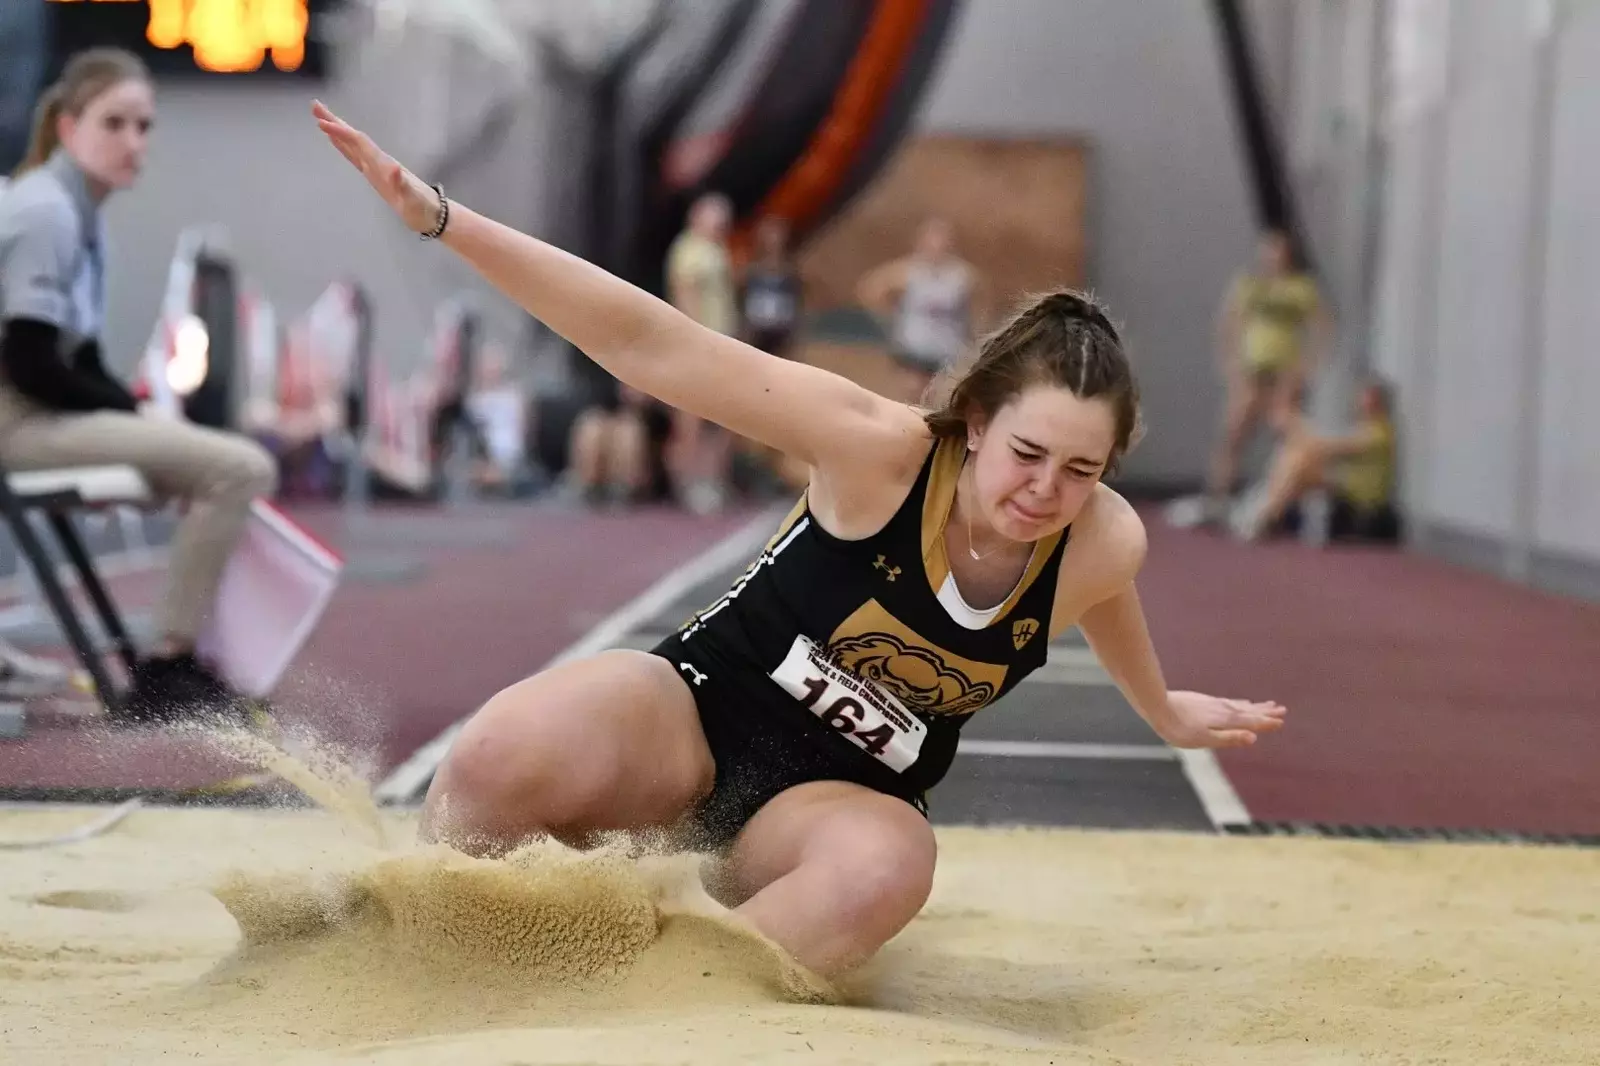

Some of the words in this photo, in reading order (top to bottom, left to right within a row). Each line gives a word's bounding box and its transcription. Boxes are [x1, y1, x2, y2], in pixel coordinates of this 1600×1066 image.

[801, 676, 896, 756] 164
[806, 651, 831, 676] TRACK
[829, 671, 837, 680] &
[837, 675, 859, 692] FIELD
[858, 688, 910, 733] CHAMPIONSHIP
[864, 679, 889, 705] LEAGUE
[887, 701, 913, 728] INDOOR
